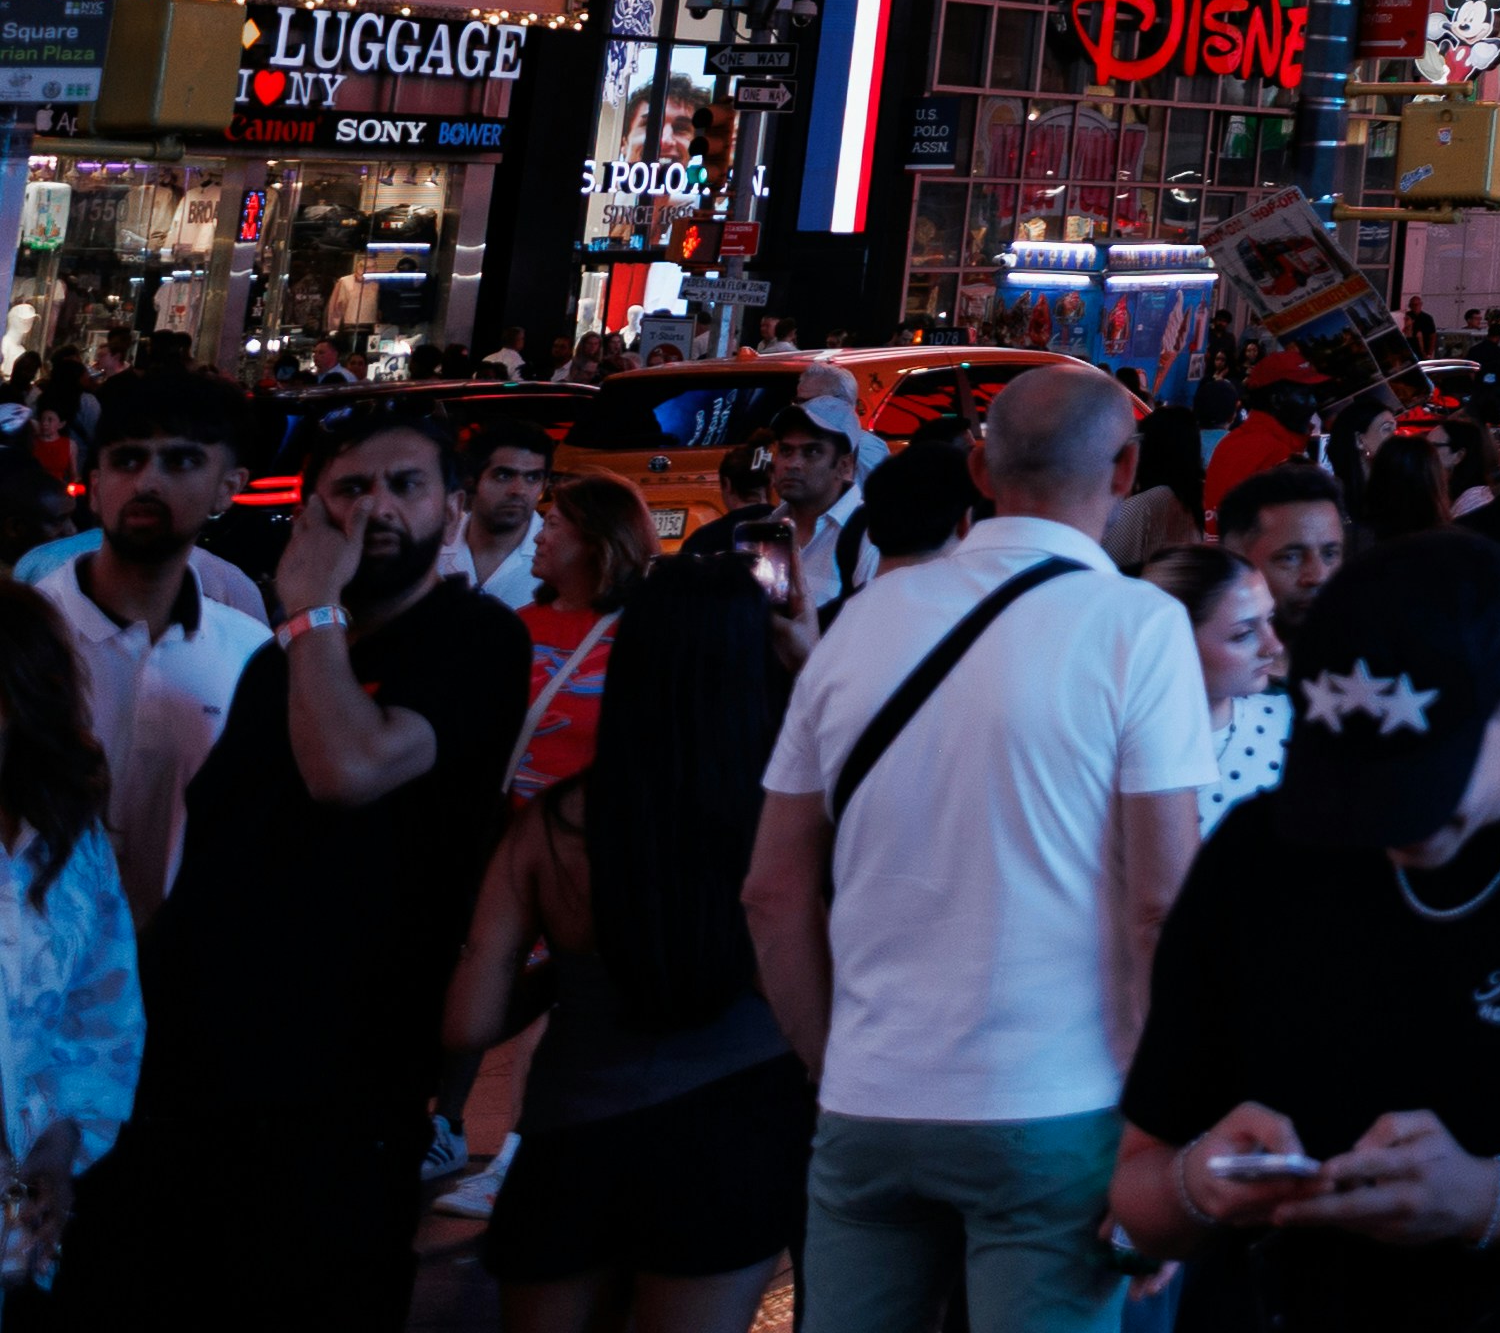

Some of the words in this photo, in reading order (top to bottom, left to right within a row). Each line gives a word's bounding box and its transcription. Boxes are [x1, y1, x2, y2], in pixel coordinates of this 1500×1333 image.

[4, 22, 78, 42] Square
[269, 6, 527, 79] LUGGAGE
[43, 45, 95, 62] Plaza
[719, 52, 745, 66] ONE
[757, 52, 785, 67] WAY
[235, 70, 253, 103] I
[285, 72, 347, 106] NY
[743, 89, 764, 102] ONE
[767, 89, 789, 102] WAY
[916, 109, 937, 120] U.S.
[224, 113, 315, 143] Canon
[335, 119, 427, 144] SONY
[438, 123, 501, 146] BOWER
[914, 125, 949, 137] POLO
[912, 141, 949, 153] ASSN.
[608, 161, 688, 195] POLO
[602, 205, 653, 224] SINCE
